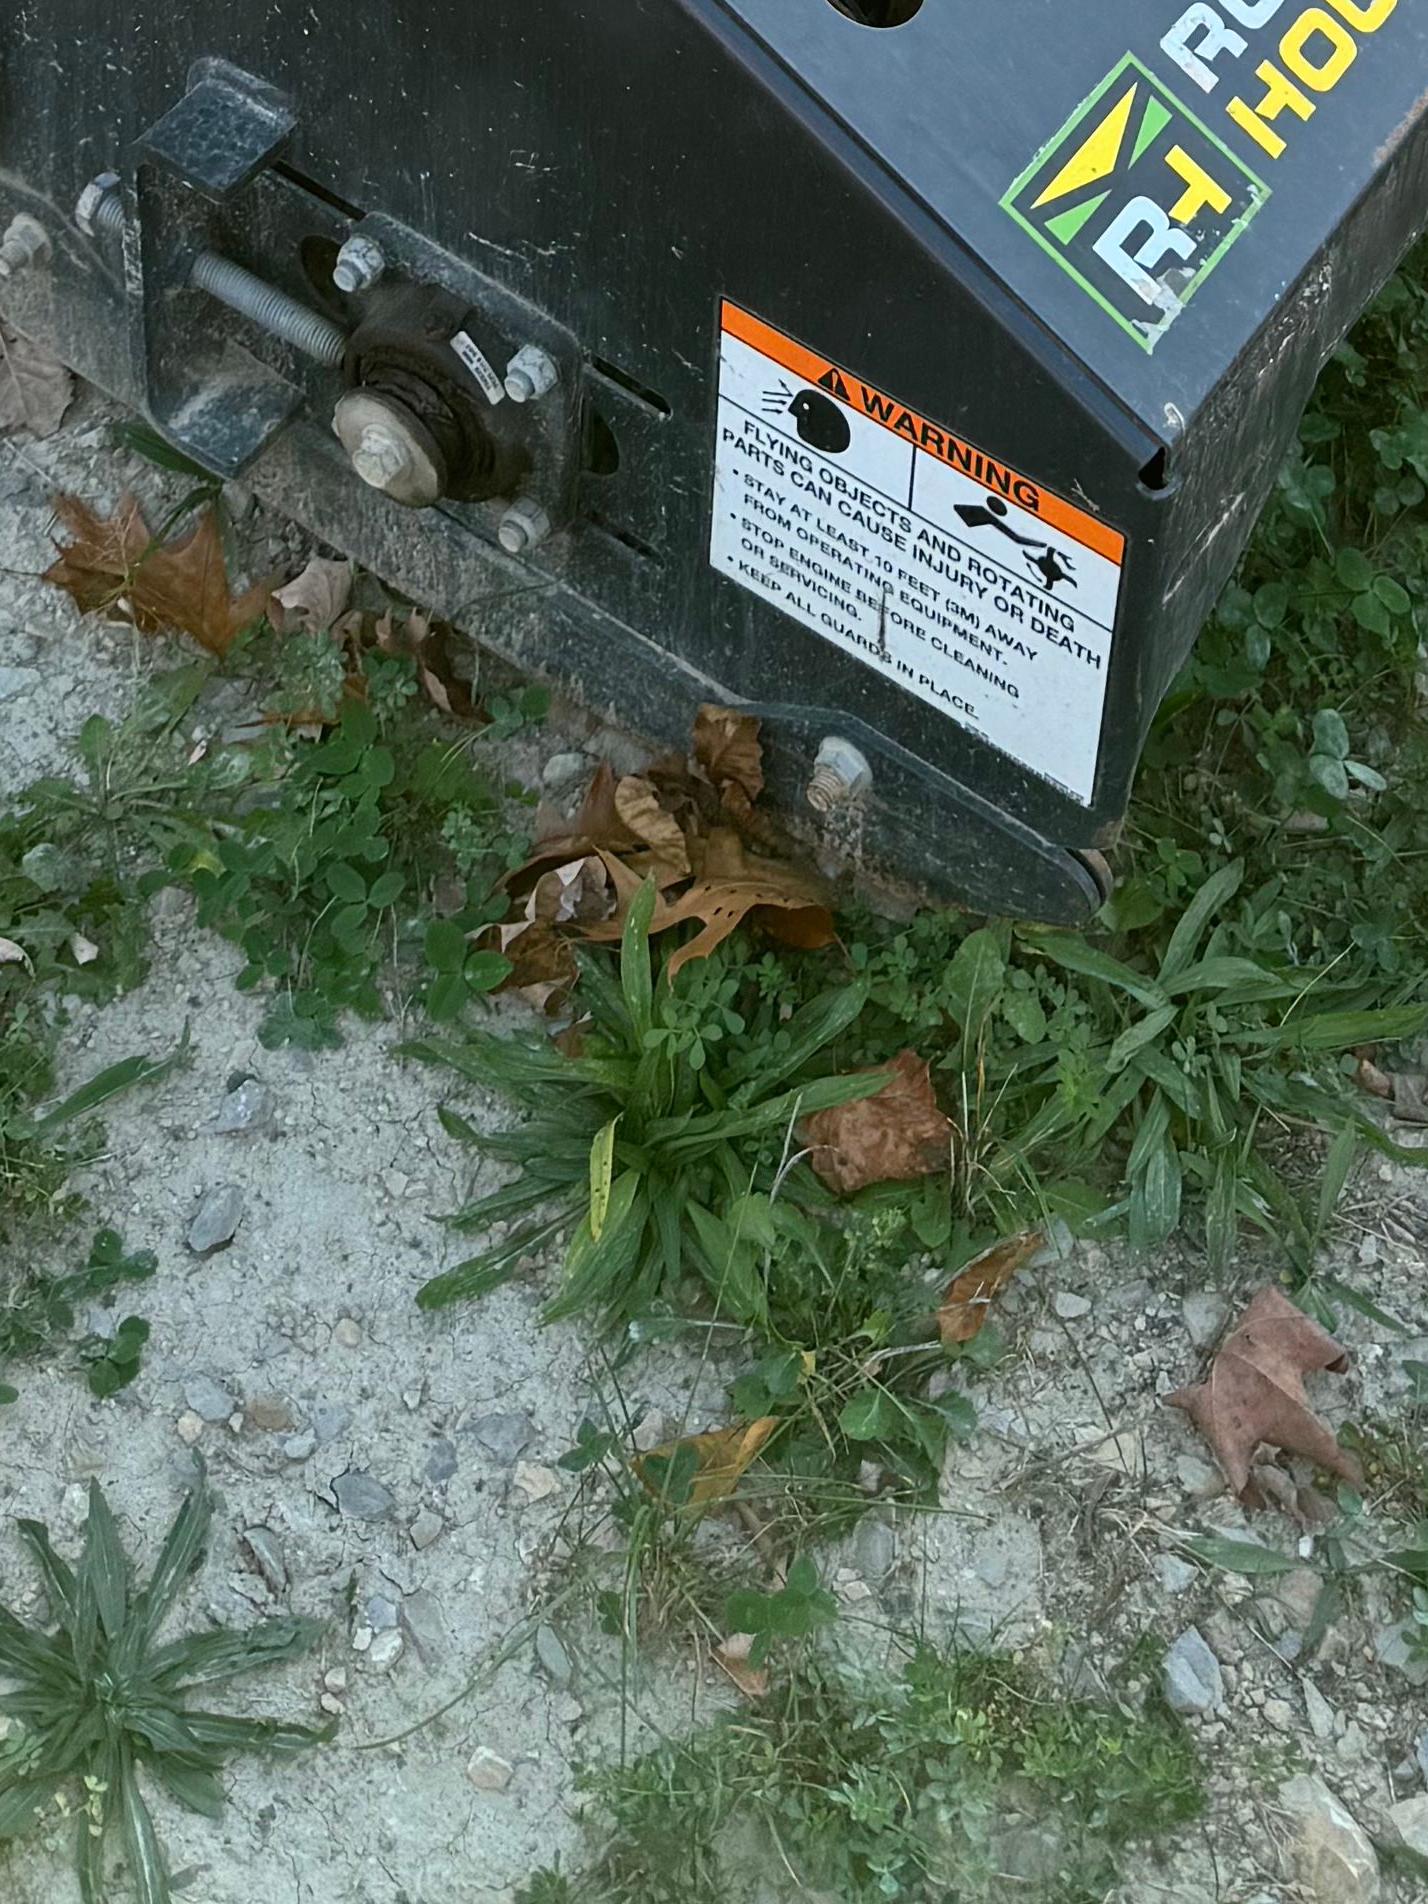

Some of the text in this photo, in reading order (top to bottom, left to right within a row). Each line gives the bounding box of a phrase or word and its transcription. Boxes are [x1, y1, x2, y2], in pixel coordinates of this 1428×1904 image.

[743, 419, 1075, 634] FLYING OBJECTS AND ROTATING
[860, 386, 1041, 514] WARNING
[722, 426, 1101, 671] PARTS CAN CAUSE INJURY OR DEATH
[738, 558, 781, 596] KEEP
[784, 587, 816, 618] ALL
[819, 610, 892, 666] GUARDS
[896, 658, 914, 679] IN
[740, 535, 862, 622] OR SERVICING.
[741, 515, 1020, 700] STOP ENGINE BEFORE CLEANING
[743, 471, 1038, 664] STAY AT LEAST 10 FEET (3M) AWAY
[743, 492, 1008, 667] FROM OPERATING EQUIPMENT.
